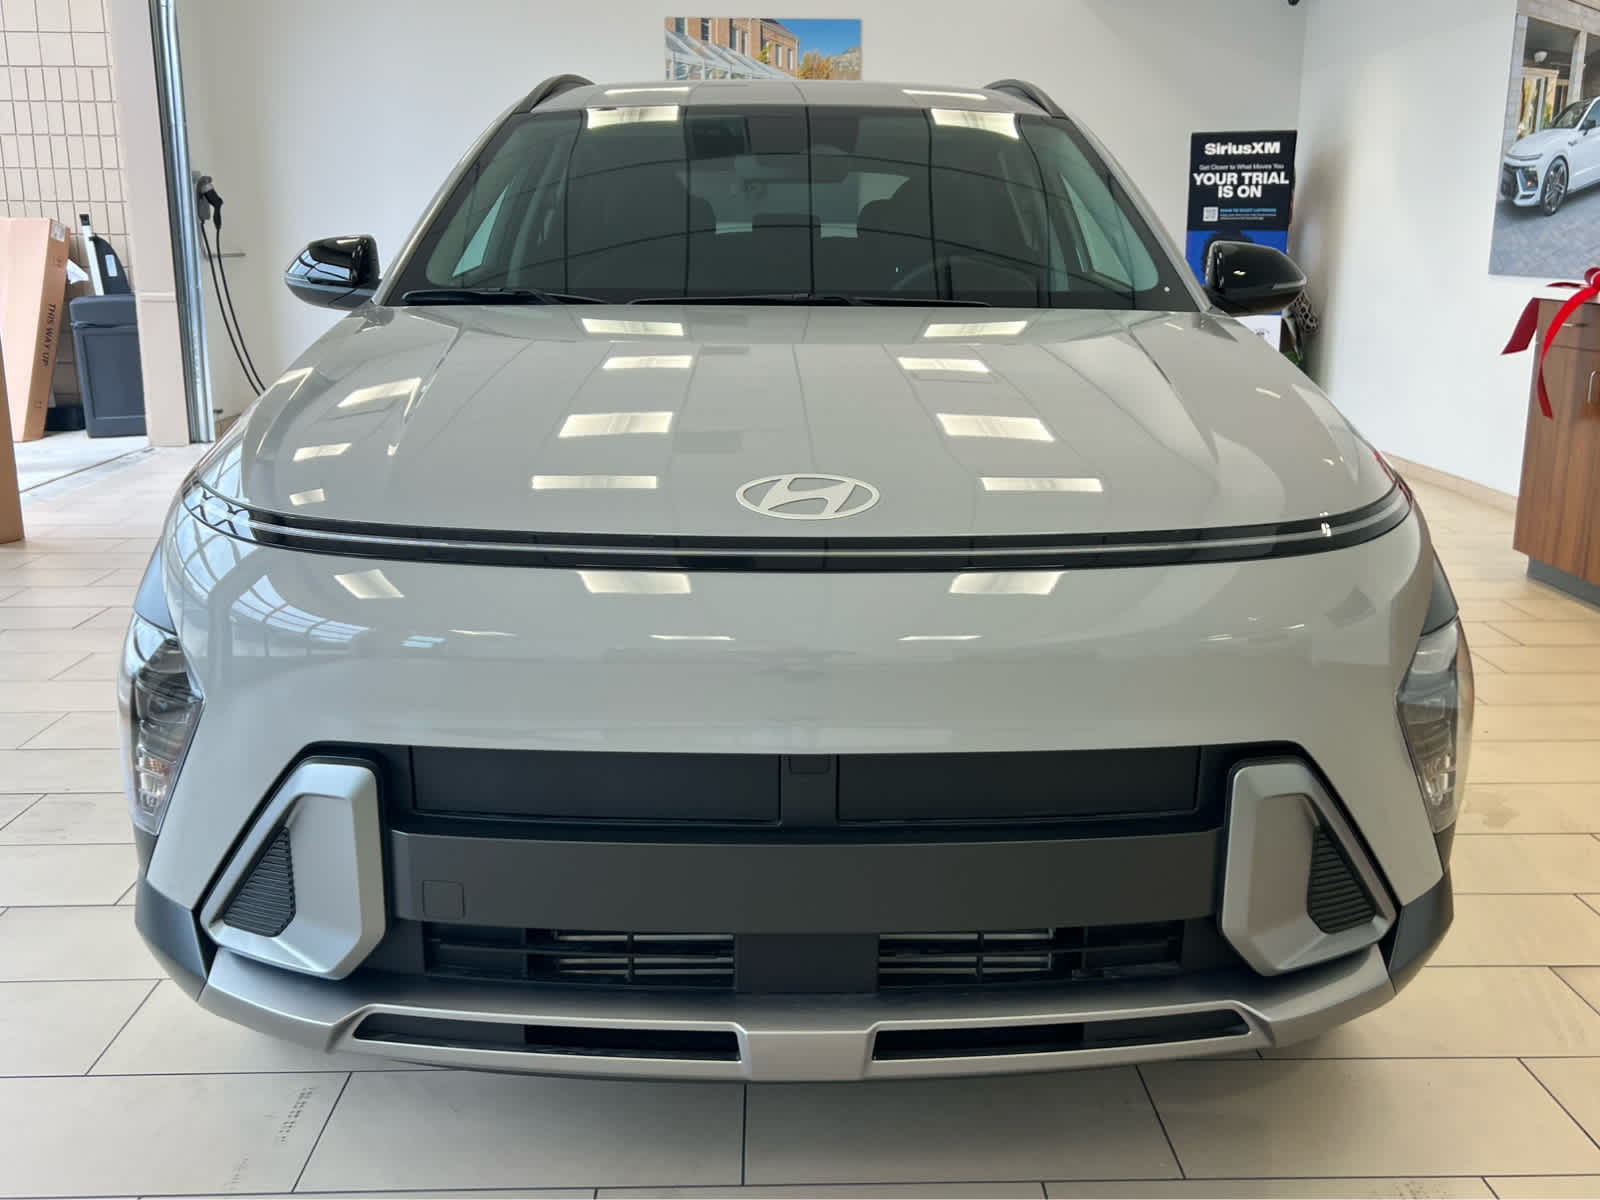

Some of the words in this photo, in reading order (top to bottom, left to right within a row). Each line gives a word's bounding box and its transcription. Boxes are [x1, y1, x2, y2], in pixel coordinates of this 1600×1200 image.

[1204, 141, 1280, 155] SiriusXM
[1193, 172, 1238, 185] YOUR
[1241, 171, 1290, 185] TRIAL
[1218, 185, 1234, 198] IS
[1237, 185, 1262, 198] ON
[47, 303, 56, 325] THIS
[44, 327, 54, 349] WAY
[41, 351, 49, 368] UP
